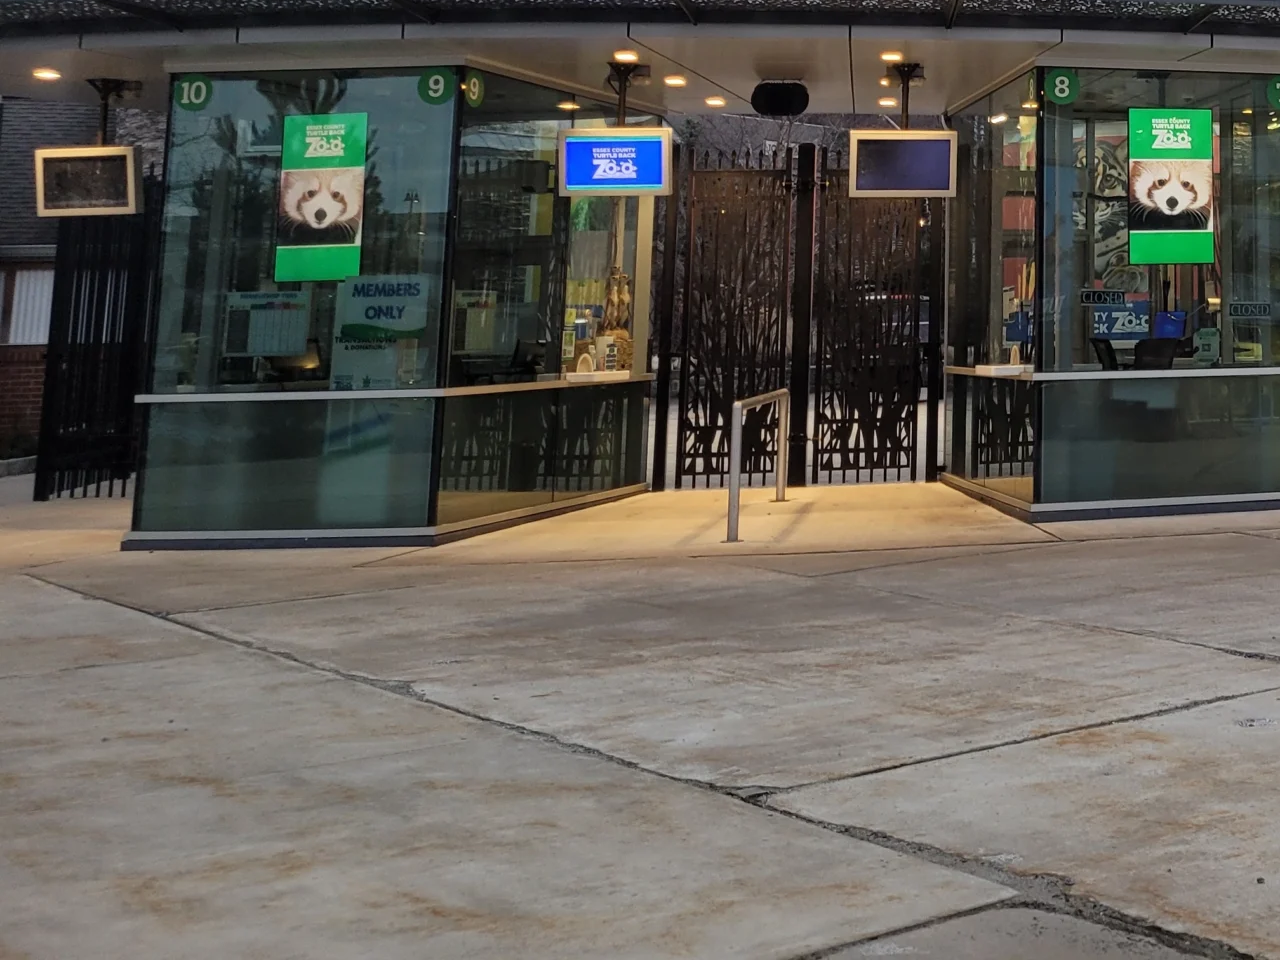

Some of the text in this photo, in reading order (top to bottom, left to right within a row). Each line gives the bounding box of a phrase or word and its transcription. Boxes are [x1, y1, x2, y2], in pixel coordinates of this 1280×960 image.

[180, 81, 207, 104] 10
[427, 74, 445, 98] 9
[469, 77, 479, 100] 9
[1054, 75, 1070, 98] 8
[351, 282, 421, 298] MEMBERS
[1082, 291, 1124, 304] CLOSED
[364, 305, 406, 320] ONLY
[1230, 304, 1270, 316] CLOSED
